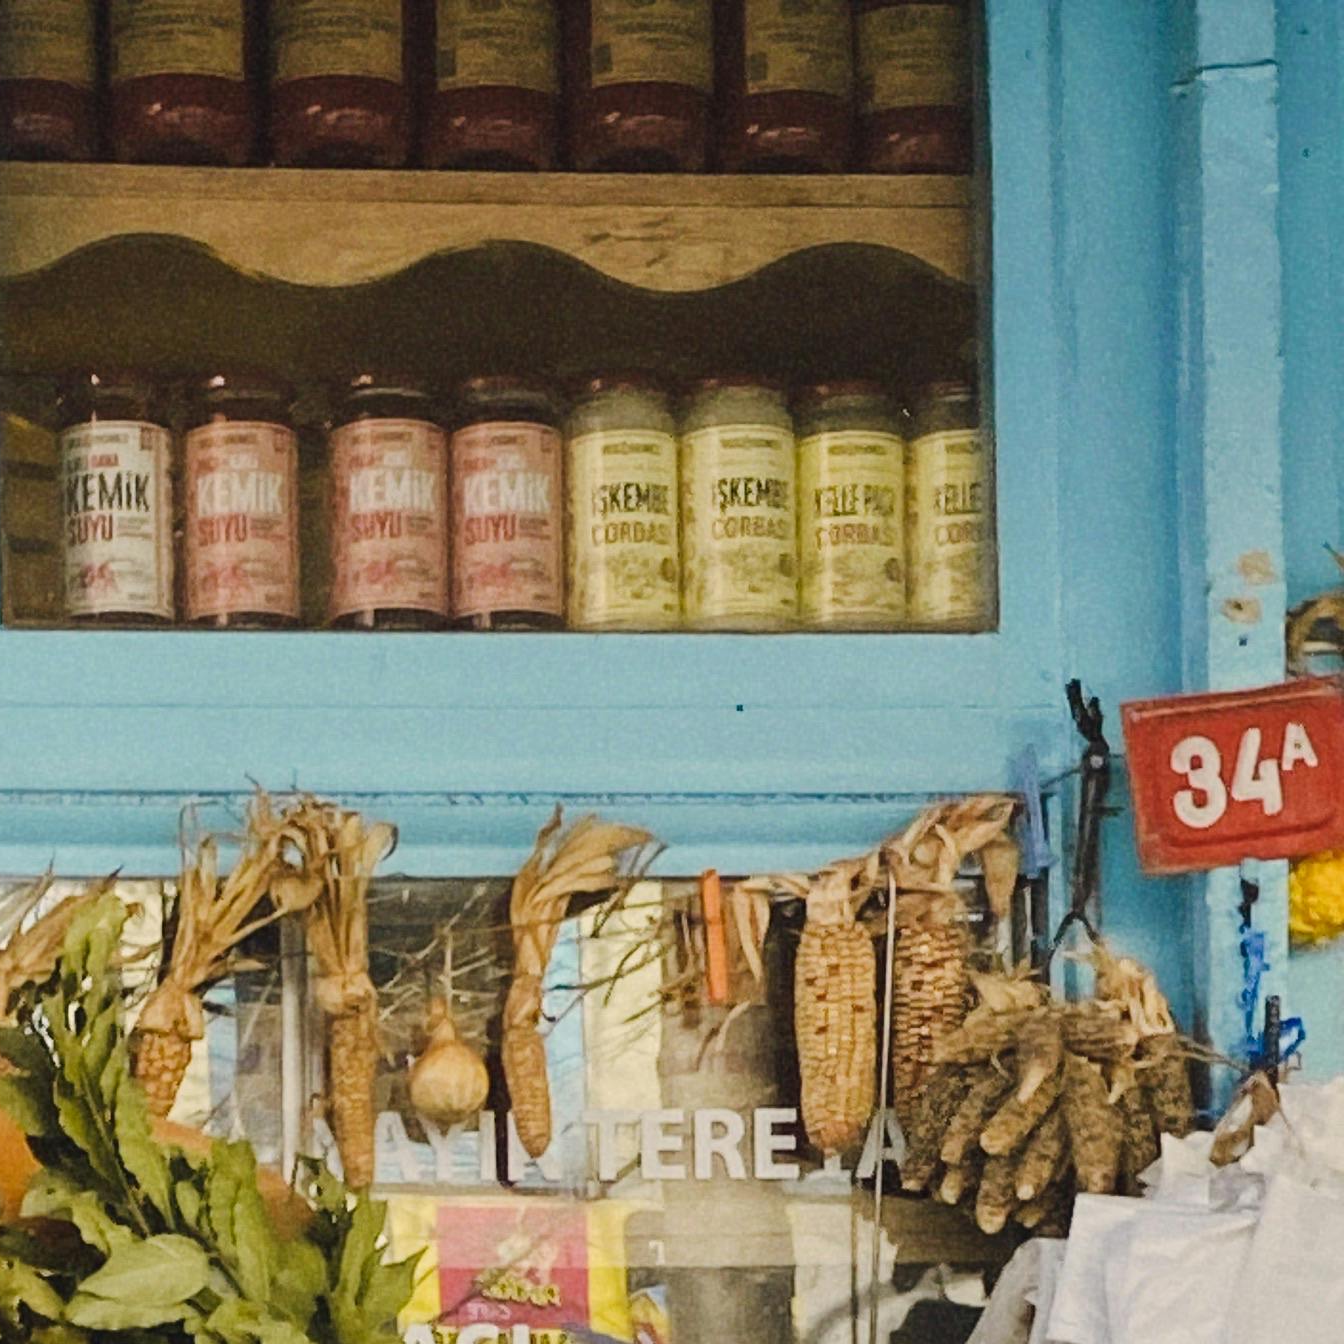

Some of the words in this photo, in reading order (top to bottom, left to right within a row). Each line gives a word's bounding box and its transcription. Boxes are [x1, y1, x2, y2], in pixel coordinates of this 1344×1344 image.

[66, 513, 114, 546] SUYU
[350, 510, 403, 543] SUYU
[464, 512, 517, 546] SUYU
[1168, 721, 1319, 829] 34A
[582, 1106, 907, 1181] TEREA
